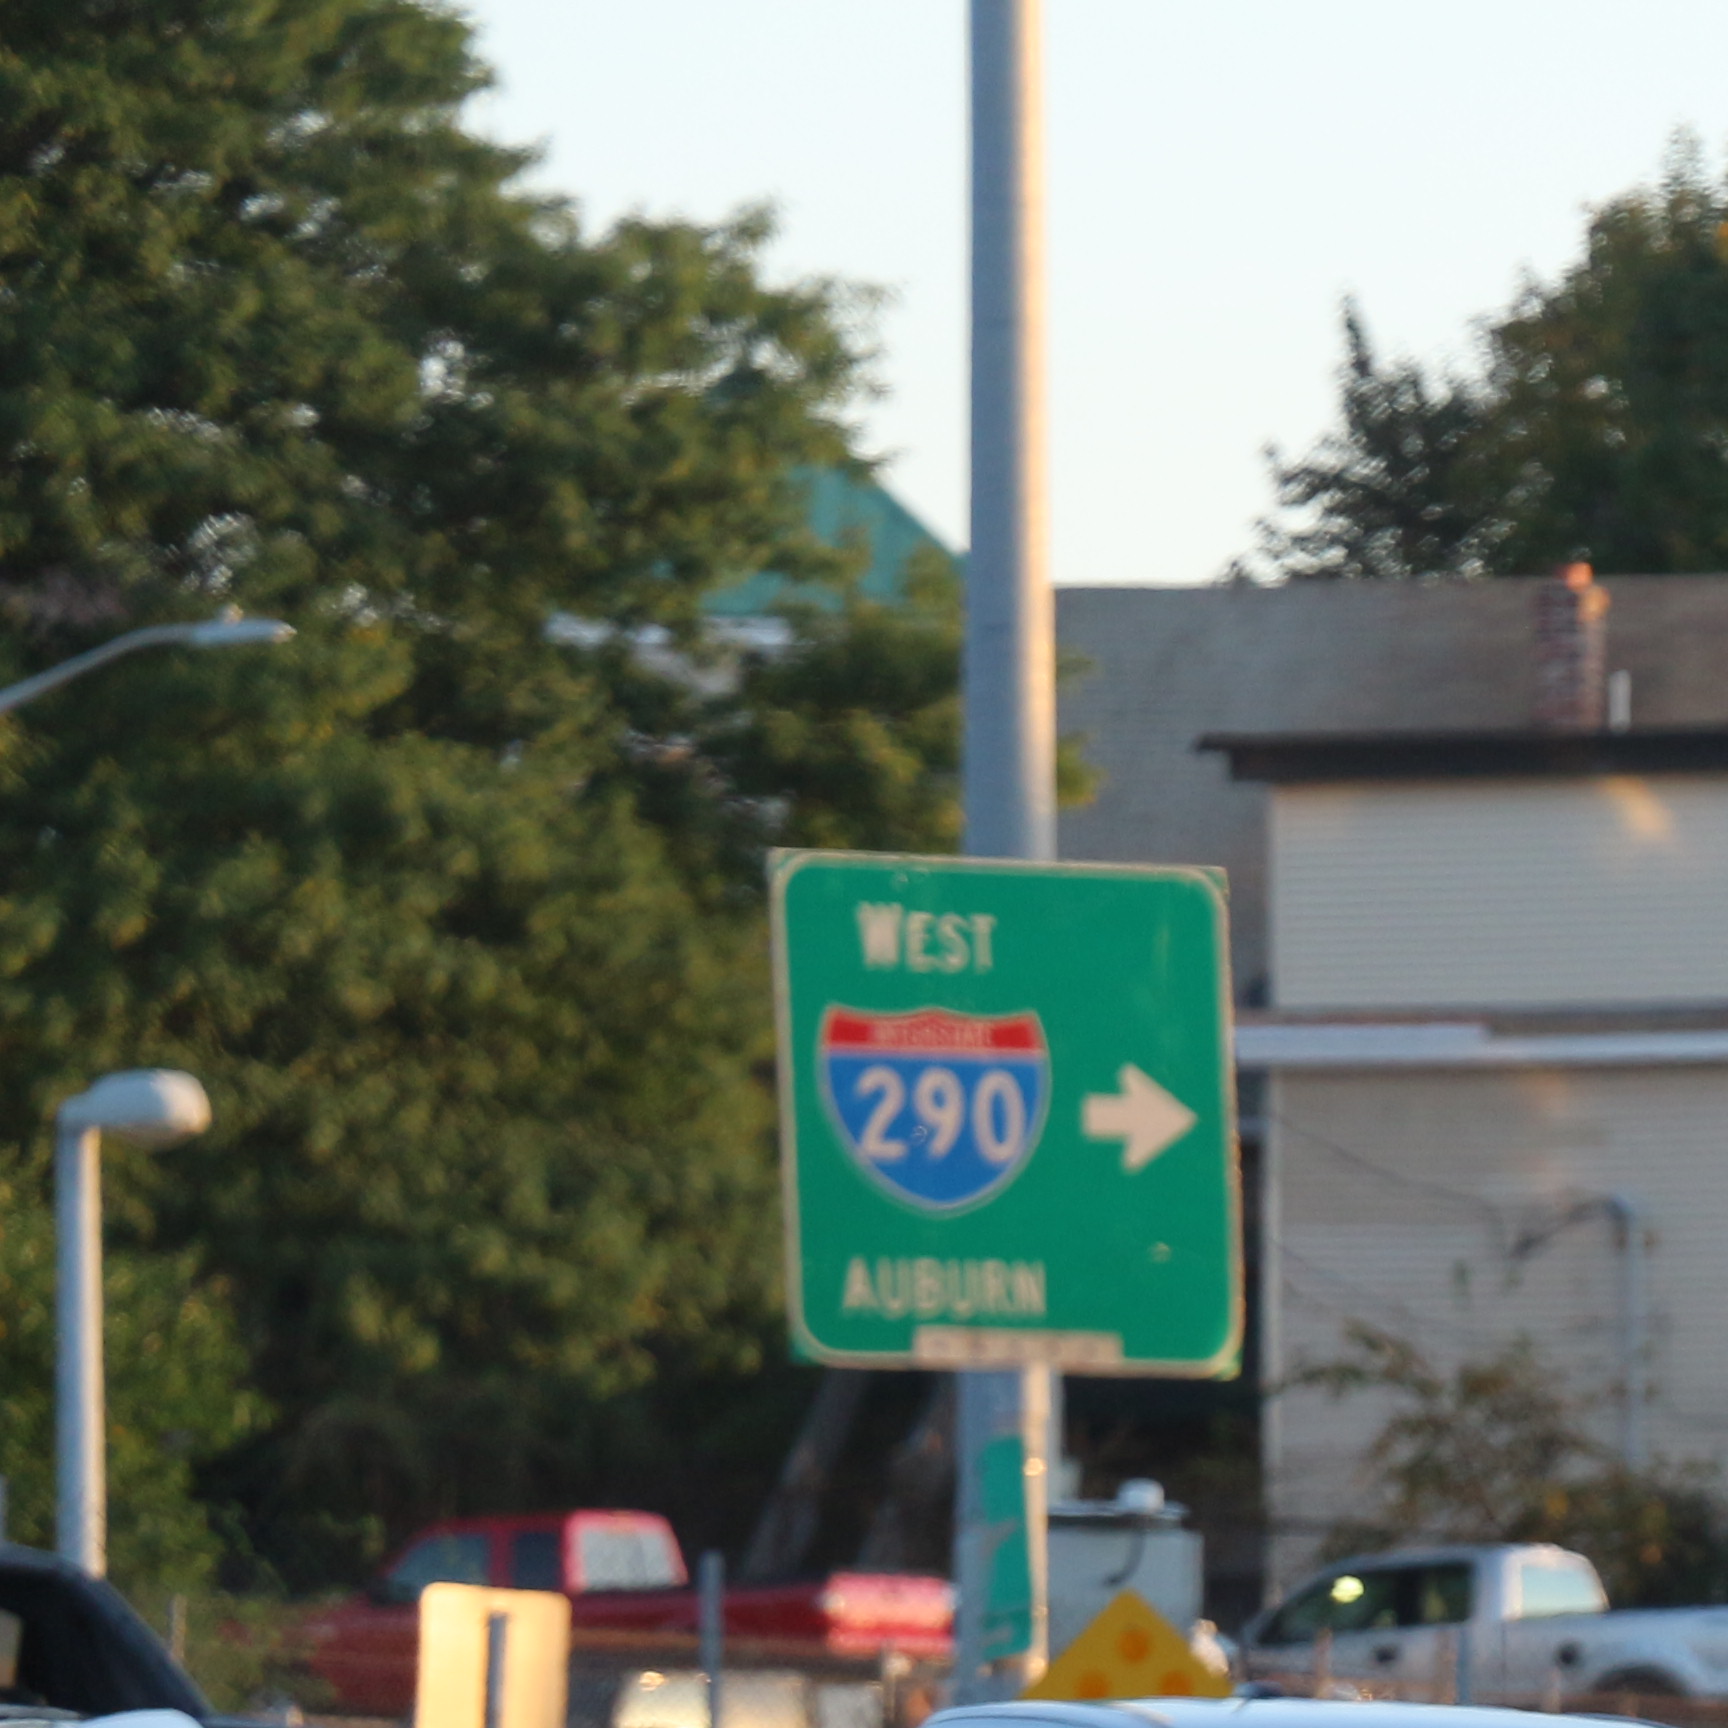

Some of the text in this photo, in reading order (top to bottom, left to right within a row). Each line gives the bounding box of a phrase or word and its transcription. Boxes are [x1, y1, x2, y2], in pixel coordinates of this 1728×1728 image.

[856, 901, 998, 973] WEST
[855, 1065, 1027, 1164] 290
[842, 1256, 1047, 1318] AUBURN
